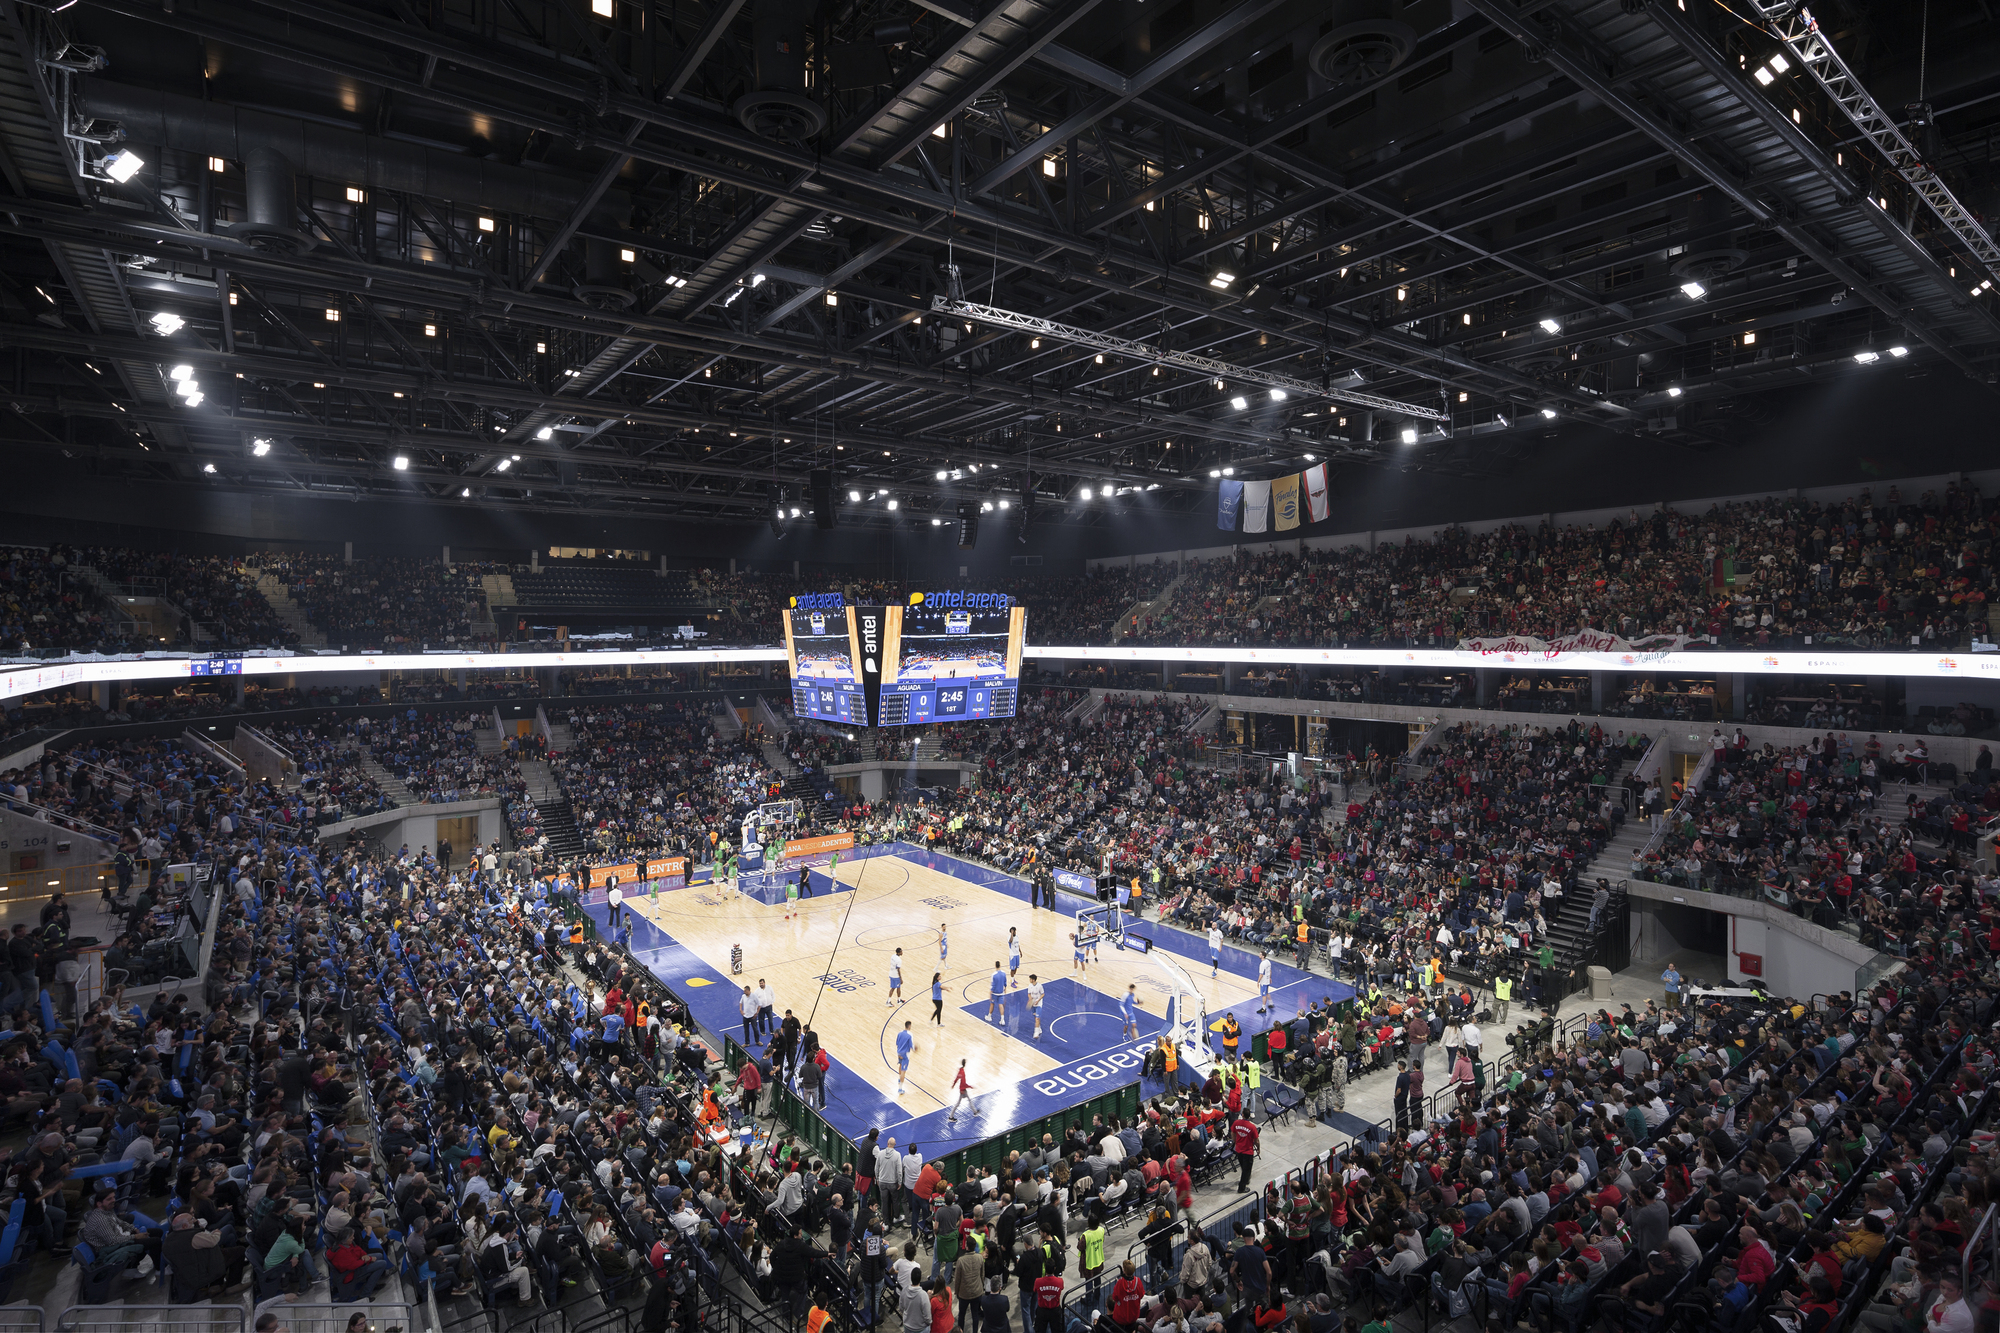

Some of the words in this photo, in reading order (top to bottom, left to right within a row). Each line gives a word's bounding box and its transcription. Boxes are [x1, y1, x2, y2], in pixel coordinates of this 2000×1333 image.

[796, 591, 817, 610] antel
[817, 592, 844, 609] arena
[924, 589, 965, 607] antel
[965, 592, 1008, 608] arena
[862, 615, 877, 653] antel
[210, 660, 224, 668] 2:45
[810, 692, 816, 702] 0
[820, 690, 834, 702] 2:45
[840, 695, 846, 706] 0
[920, 695, 927, 706] 0
[941, 691, 963, 702] 2:45
[976, 692, 983, 702] 0
[23, 837, 49, 847] 104
[1033, 1052, 1139, 1096] arena
[1299, 1212, 1307, 1224] 7
[1039, 1285, 1060, 1293] CONTROL
